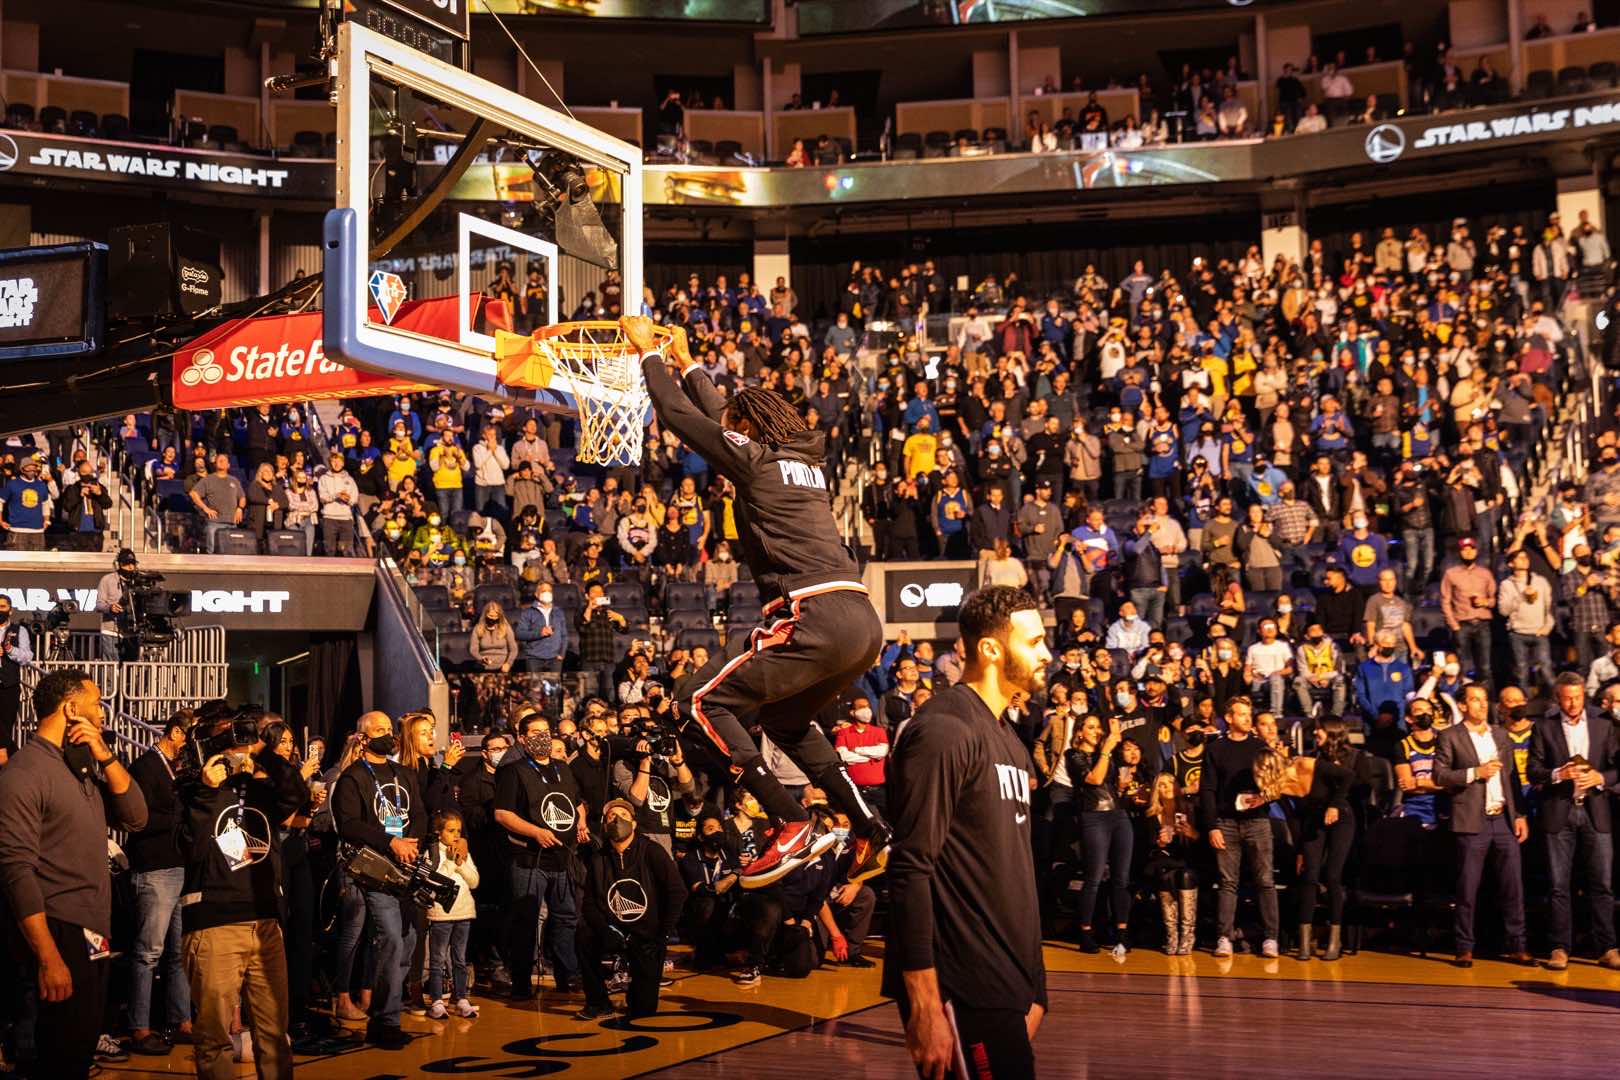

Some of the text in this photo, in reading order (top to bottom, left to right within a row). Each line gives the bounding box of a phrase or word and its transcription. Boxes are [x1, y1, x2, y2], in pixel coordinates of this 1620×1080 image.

[1414, 122, 1491, 149] STAR
[1490, 110, 1570, 138] WARS
[30, 148, 288, 188] STAR WARS NIGHT
[226, 339, 346, 382] StateFa
[191, 590, 290, 613] IGHT
